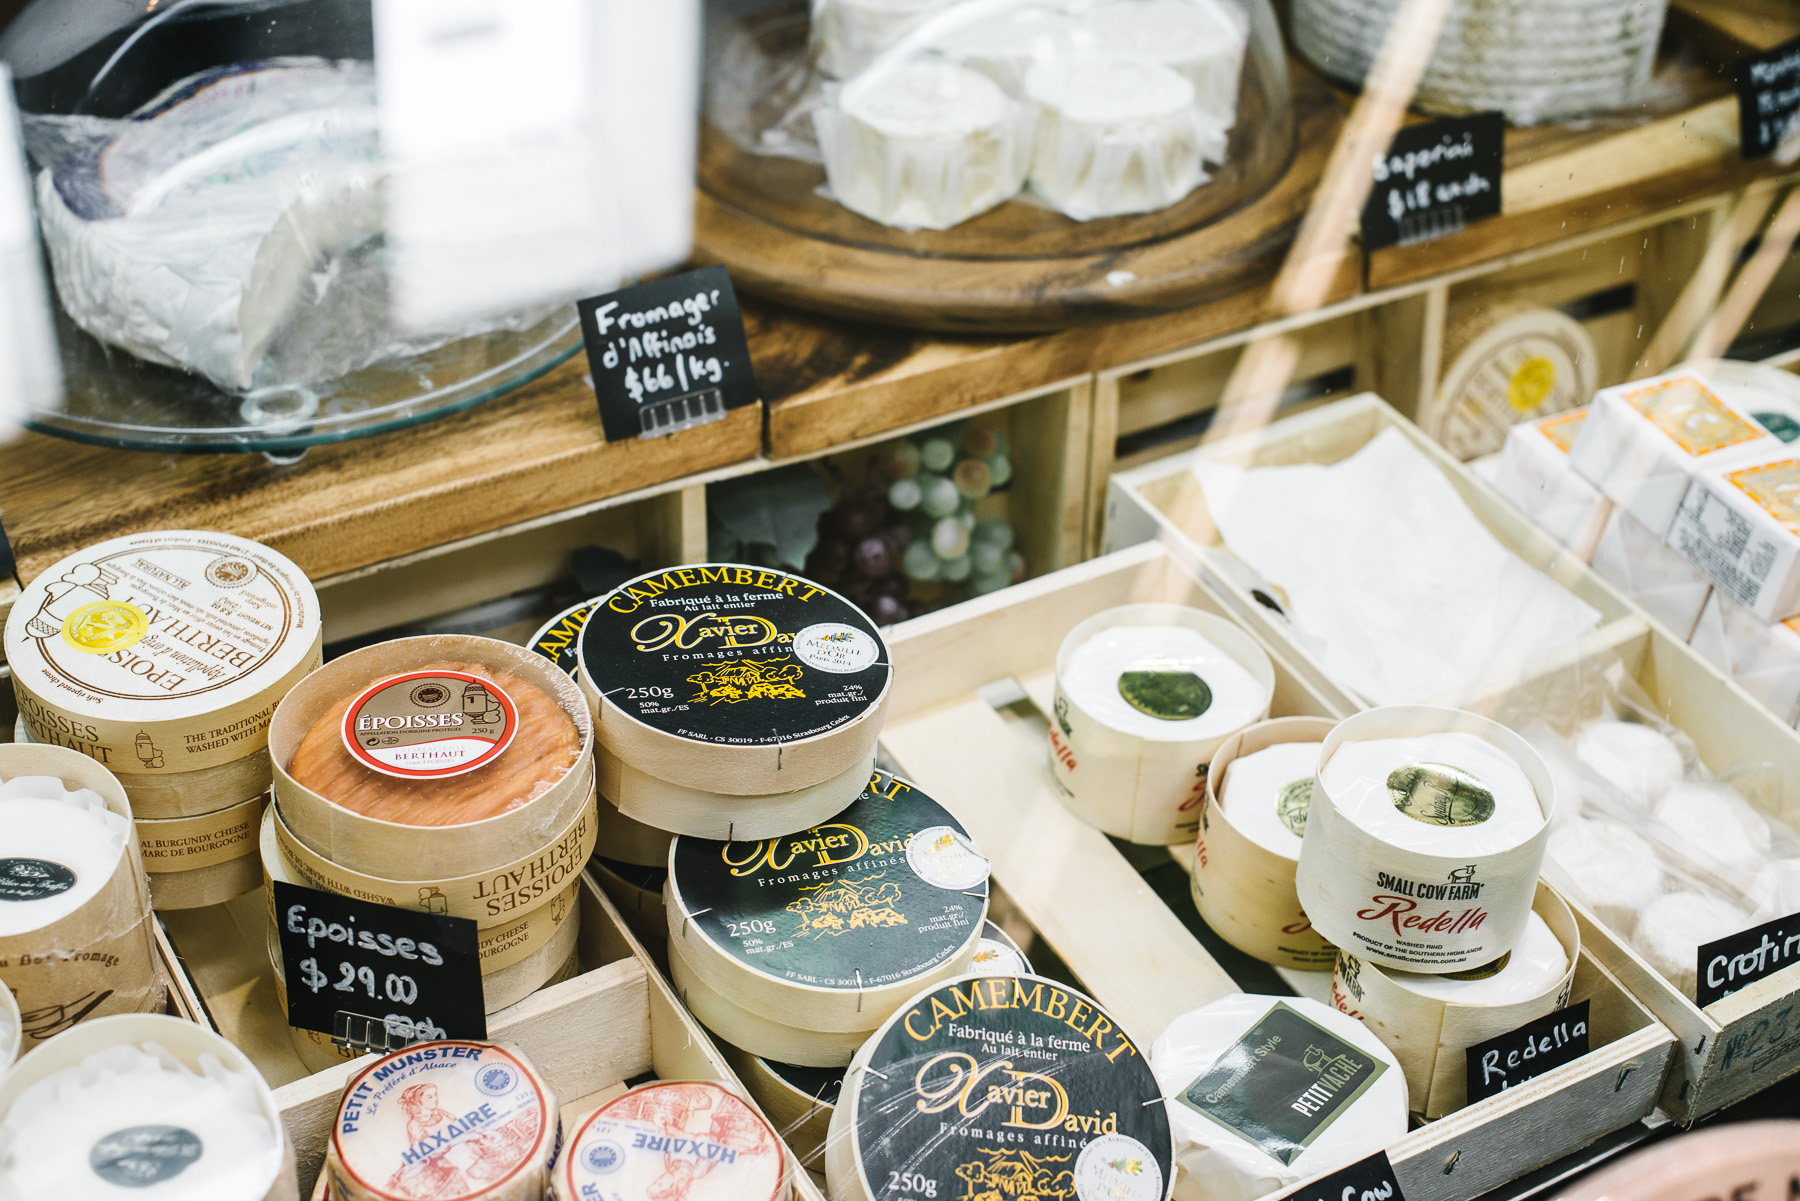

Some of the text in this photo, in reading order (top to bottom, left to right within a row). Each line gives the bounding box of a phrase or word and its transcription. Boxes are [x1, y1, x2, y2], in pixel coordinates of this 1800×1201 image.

[595, 289, 720, 335] Fromager
[135, 559, 172, 581] NATURAL
[173, 578, 187, 588] ALL
[608, 566, 828, 614] CAMEMBERT
[649, 591, 785, 608] Fabriqué à la ferme
[684, 602, 756, 612] Au lait entier
[662, 645, 793, 662] Fromages affin
[98, 650, 188, 692] EPOIS
[39, 668, 102, 706] Soft ripened cheese
[625, 686, 674, 700] 250g
[815, 695, 868, 706] produit fini
[15, 680, 99, 742] EPOISSES
[358, 713, 464, 731] ÉPOISSES
[641, 704, 690, 715] mat.gr./ES
[184, 709, 272, 745] THE TRADITIONAL
[688, 731, 708, 740] SARL
[728, 736, 752, 744] 30019
[792, 723, 831, 739] Strasbourg
[830, 714, 850, 728] Cedex
[186, 738, 229, 755] WASHED
[231, 727, 258, 744] WITH
[395, 750, 465, 760] BERTHAUT
[155, 833, 212, 848] BURGUNDY
[214, 821, 250, 839] CHEESE
[170, 849, 184, 857] DE
[187, 831, 250, 855] BOURGOGNE
[474, 817, 588, 899] BERTHAUT
[758, 856, 905, 887] Fromages affinés
[326, 878, 352, 893] WITH
[488, 844, 584, 917] EPOISSES
[1377, 871, 1481, 900] SMALL COW FARM
[353, 885, 395, 906] WASHED
[943, 904, 963, 914] 24%
[727, 919, 776, 938] 250g
[918, 918, 970, 934] produit fini
[1356, 895, 1488, 937] Redella
[288, 904, 444, 966] Epoisses
[496, 921, 530, 944] CHEESE
[742, 938, 763, 948] 50%
[1353, 931, 1383, 947] PRODUCT
[1395, 946, 1407, 954] THE
[1408, 949, 1446, 957] SOUTHERN
[1446, 946, 1483, 957] HIGHLANDS
[1396, 939, 1425, 949] WASHED
[479, 933, 530, 960] OURGOGNE
[745, 940, 794, 955] mat.gr./ES
[1366, 945, 1467, 964] www.smallcowfarm.com.au
[785, 970, 795, 978] FF
[797, 973, 817, 984] SARL
[825, 978, 835, 986] CS
[869, 973, 901, 984] F-67016
[901, 957, 937, 977] Strasbourg
[935, 944, 956, 961] Cedex
[904, 979, 1137, 1064] CAMEMBERT
[948, 1023, 1091, 1052] Fabriqué à la ferme
[981, 1042, 1058, 1061] Au lait entier
[1482, 1021, 1587, 1086] Redella
[1206, 1035, 1282, 1104] Camembert Style
[343, 1081, 374, 1134] PETIT
[372, 1046, 483, 1082] MUNSTER
[366, 1062, 457, 1116] Le Préféré d'Alsace
[915, 1052, 1052, 1119] Xavier
[939, 1122, 1087, 1149] Fromages affiné
[888, 1171, 938, 1198] 250g
